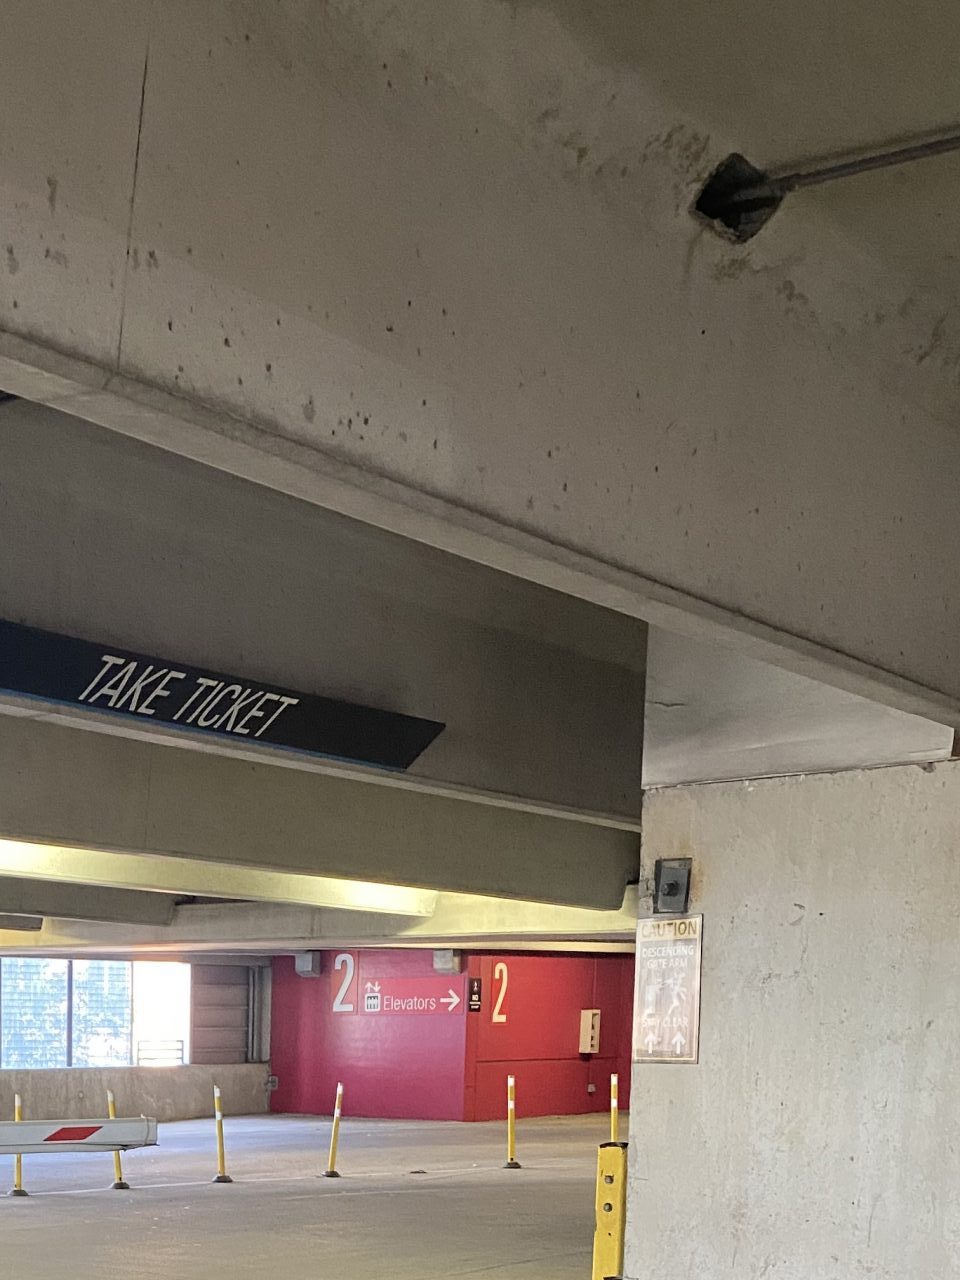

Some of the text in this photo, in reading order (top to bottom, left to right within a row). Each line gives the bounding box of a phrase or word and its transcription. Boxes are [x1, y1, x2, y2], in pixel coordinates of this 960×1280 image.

[78, 654, 300, 737] TAKE TICKET
[641, 920, 697, 938] CAUTION
[333, 953, 355, 1012] 2
[383, 995, 436, 1011] Elevators
[492, 962, 508, 1023] 2
